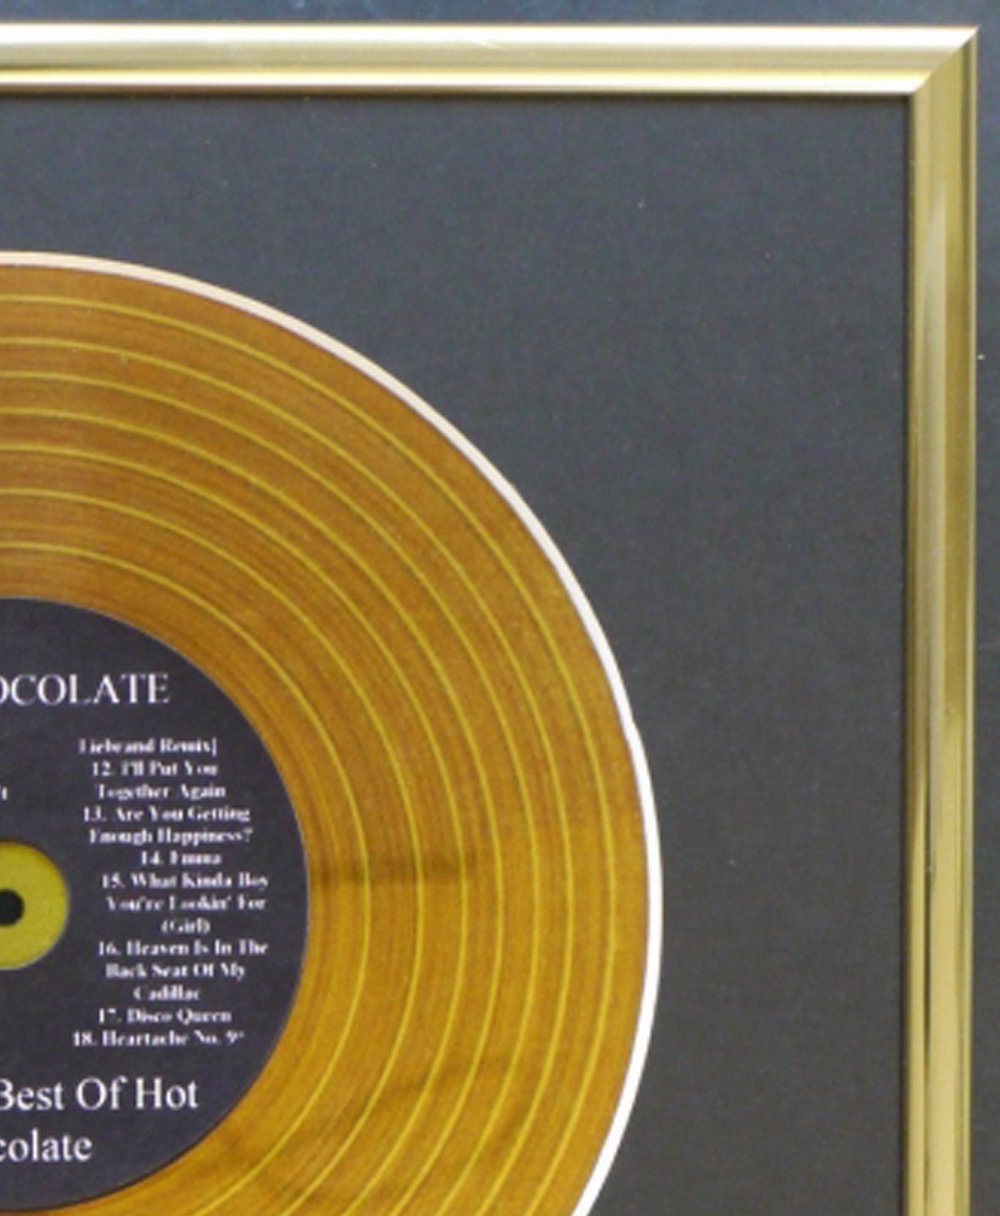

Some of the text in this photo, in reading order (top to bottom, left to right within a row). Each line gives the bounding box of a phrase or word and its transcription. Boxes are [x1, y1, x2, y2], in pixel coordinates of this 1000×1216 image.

[150, 760, 177, 776] Put
[184, 761, 218, 776] You
[95, 783, 226, 800] Together Again
[115, 806, 144, 822] Are
[149, 806, 183, 821] You
[188, 806, 252, 822] Getting
[89, 828, 253, 847] Enough Happiness?
[169, 851, 221, 865] Emma
[131, 872, 176, 889] What
[181, 872, 232, 888] Kinda
[239, 871, 269, 891] Boy
[106, 894, 266, 911] You're Lookin' For
[161, 918, 211, 935] (Girl)
[126, 939, 189, 955] Heaven
[193, 939, 208, 955] Is
[215, 939, 232, 955] In
[239, 939, 269, 955] The
[105, 962, 245, 981] Back Seat Of My
[127, 1008, 172, 1024] Disco
[177, 1008, 232, 1025] Queen
[102, 1030, 189, 1046] Heartache
[75, 1076, 127, 1110] Of
[135, 1077, 199, 1109] Hot
